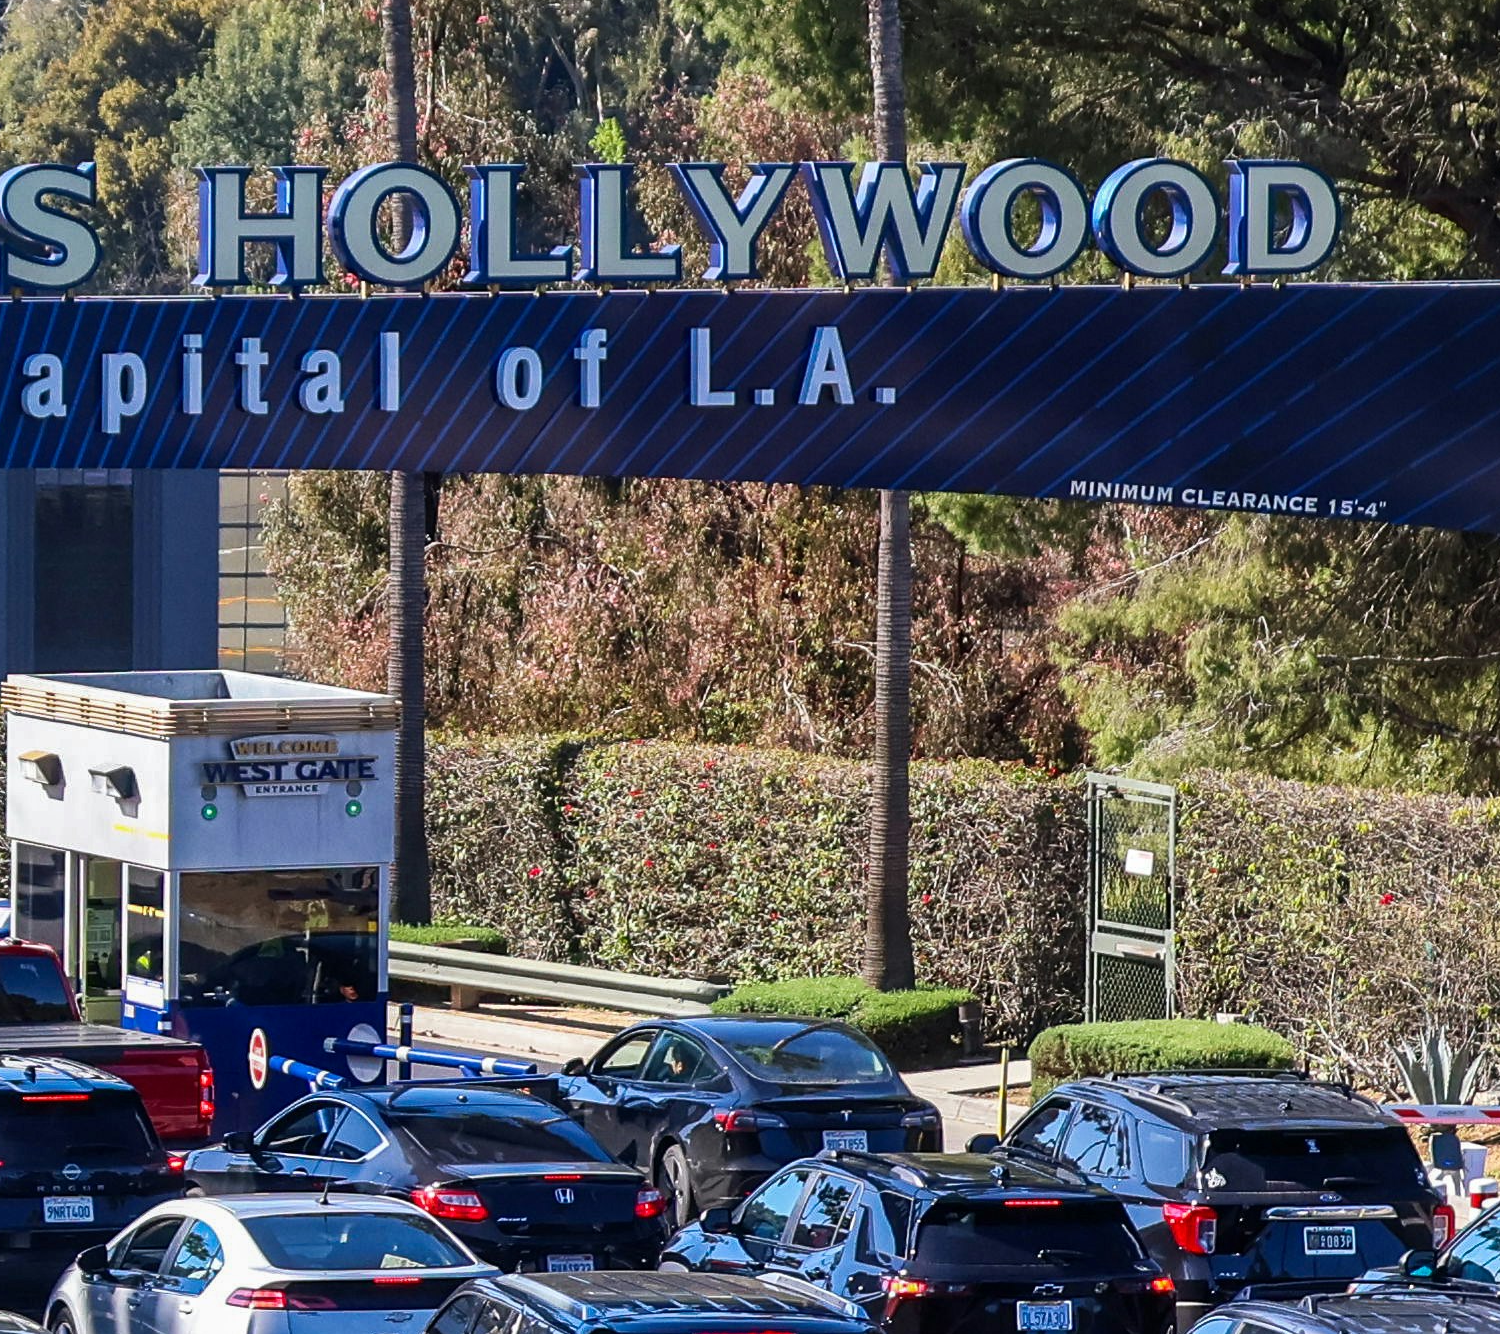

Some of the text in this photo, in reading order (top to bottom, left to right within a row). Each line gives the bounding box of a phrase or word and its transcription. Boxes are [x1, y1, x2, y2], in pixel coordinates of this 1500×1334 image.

[196, 158, 1341, 288] HOLLYWOOD
[496, 327, 609, 412] of
[688, 324, 899, 408] L.A.
[1069, 480, 1174, 503] MINIMUM
[1181, 488, 1319, 513] CLEARANCE
[235, 739, 339, 756] WELCOME
[202, 758, 375, 784] WEST GATE
[255, 784, 319, 794] ENTRANCE
